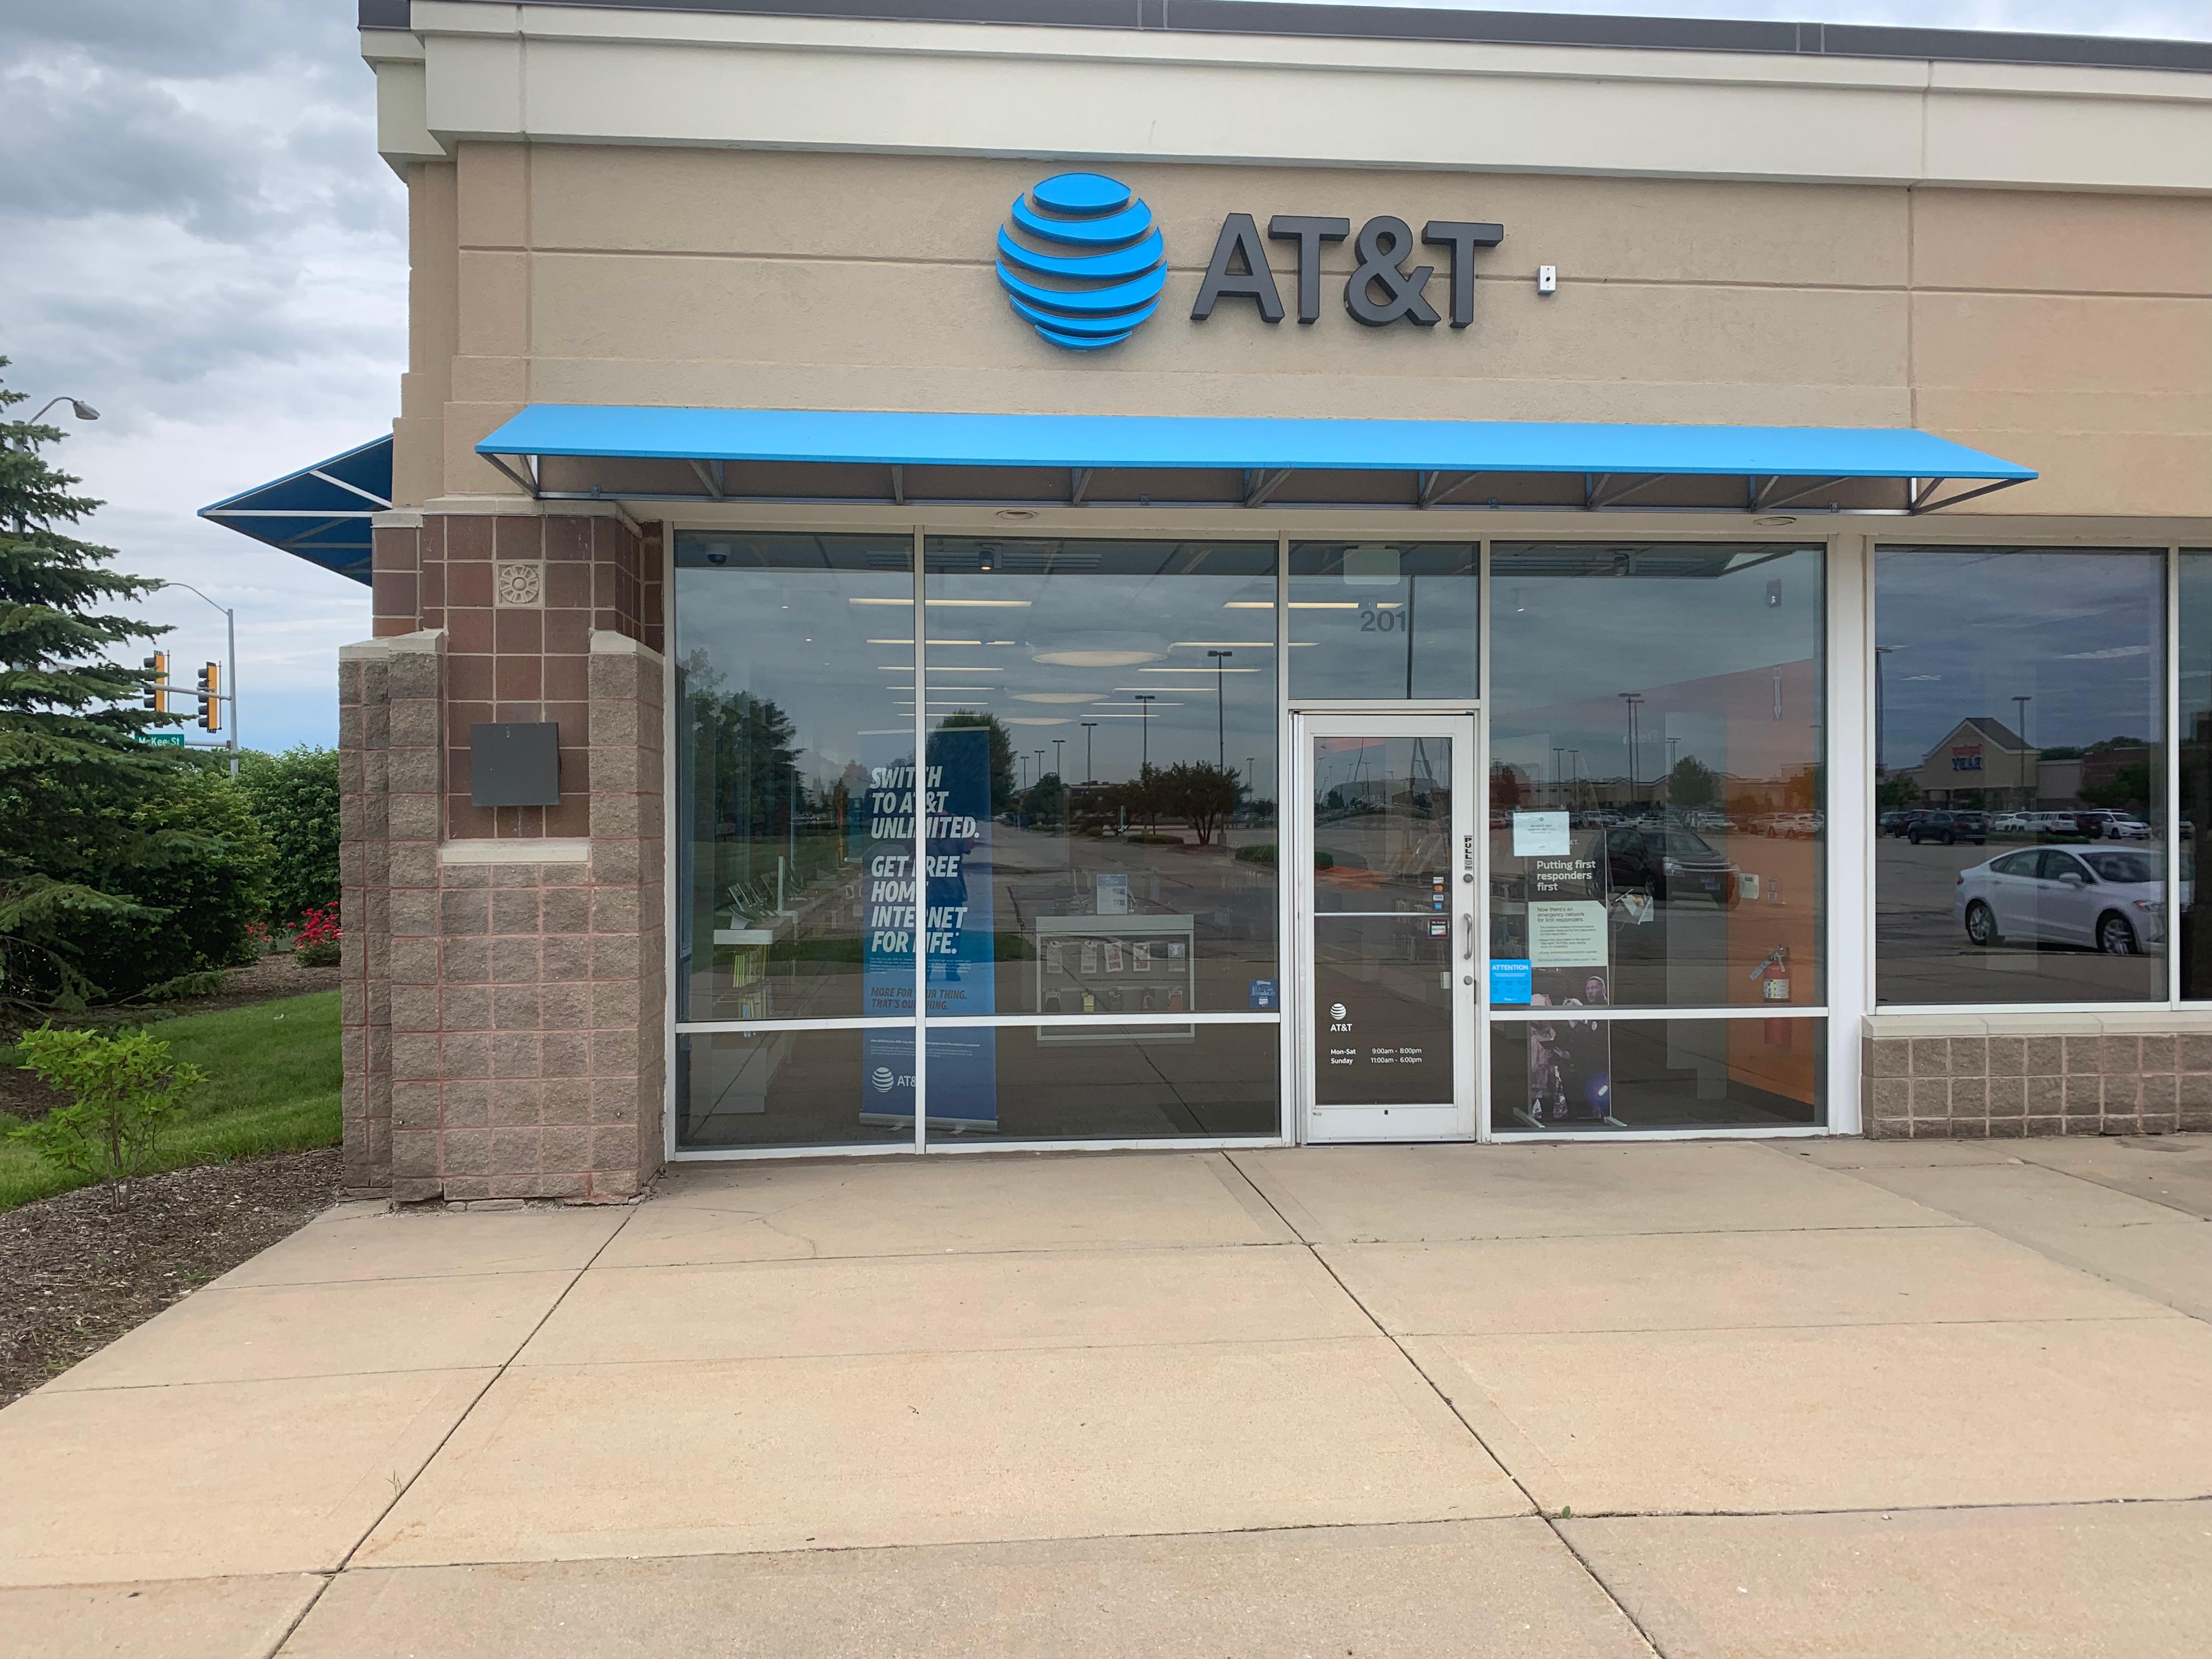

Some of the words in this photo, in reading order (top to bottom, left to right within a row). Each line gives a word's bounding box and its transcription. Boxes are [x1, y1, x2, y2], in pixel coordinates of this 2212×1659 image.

[1191, 213, 1504, 328] AT&T
[1360, 610, 1406, 631] 201
[171, 737, 180, 746] St
[870, 766, 943, 789] SWITH
[872, 792, 897, 814] TO
[899, 791, 950, 814] A&T
[871, 856, 909, 877] GET
[912, 856, 960, 878] REE
[1537, 860, 1573, 871] Putting
[1575, 859, 1596, 868] first
[1537, 871, 1592, 882] responders
[871, 881, 929, 902] HOM
[1537, 882, 1558, 891] first
[871, 906, 968, 928] INTENET
[871, 931, 909, 953] FOR
[871, 988, 896, 997] MORE
[897, 988, 913, 997] FOR
[940, 990, 967, 1000] THING.
[872, 999, 901, 1008] THAT'S
[926, 1001, 949, 1010] HING.
[1330, 1024, 1353, 1032] AT&T
[897, 1075, 916, 1087] AT&
